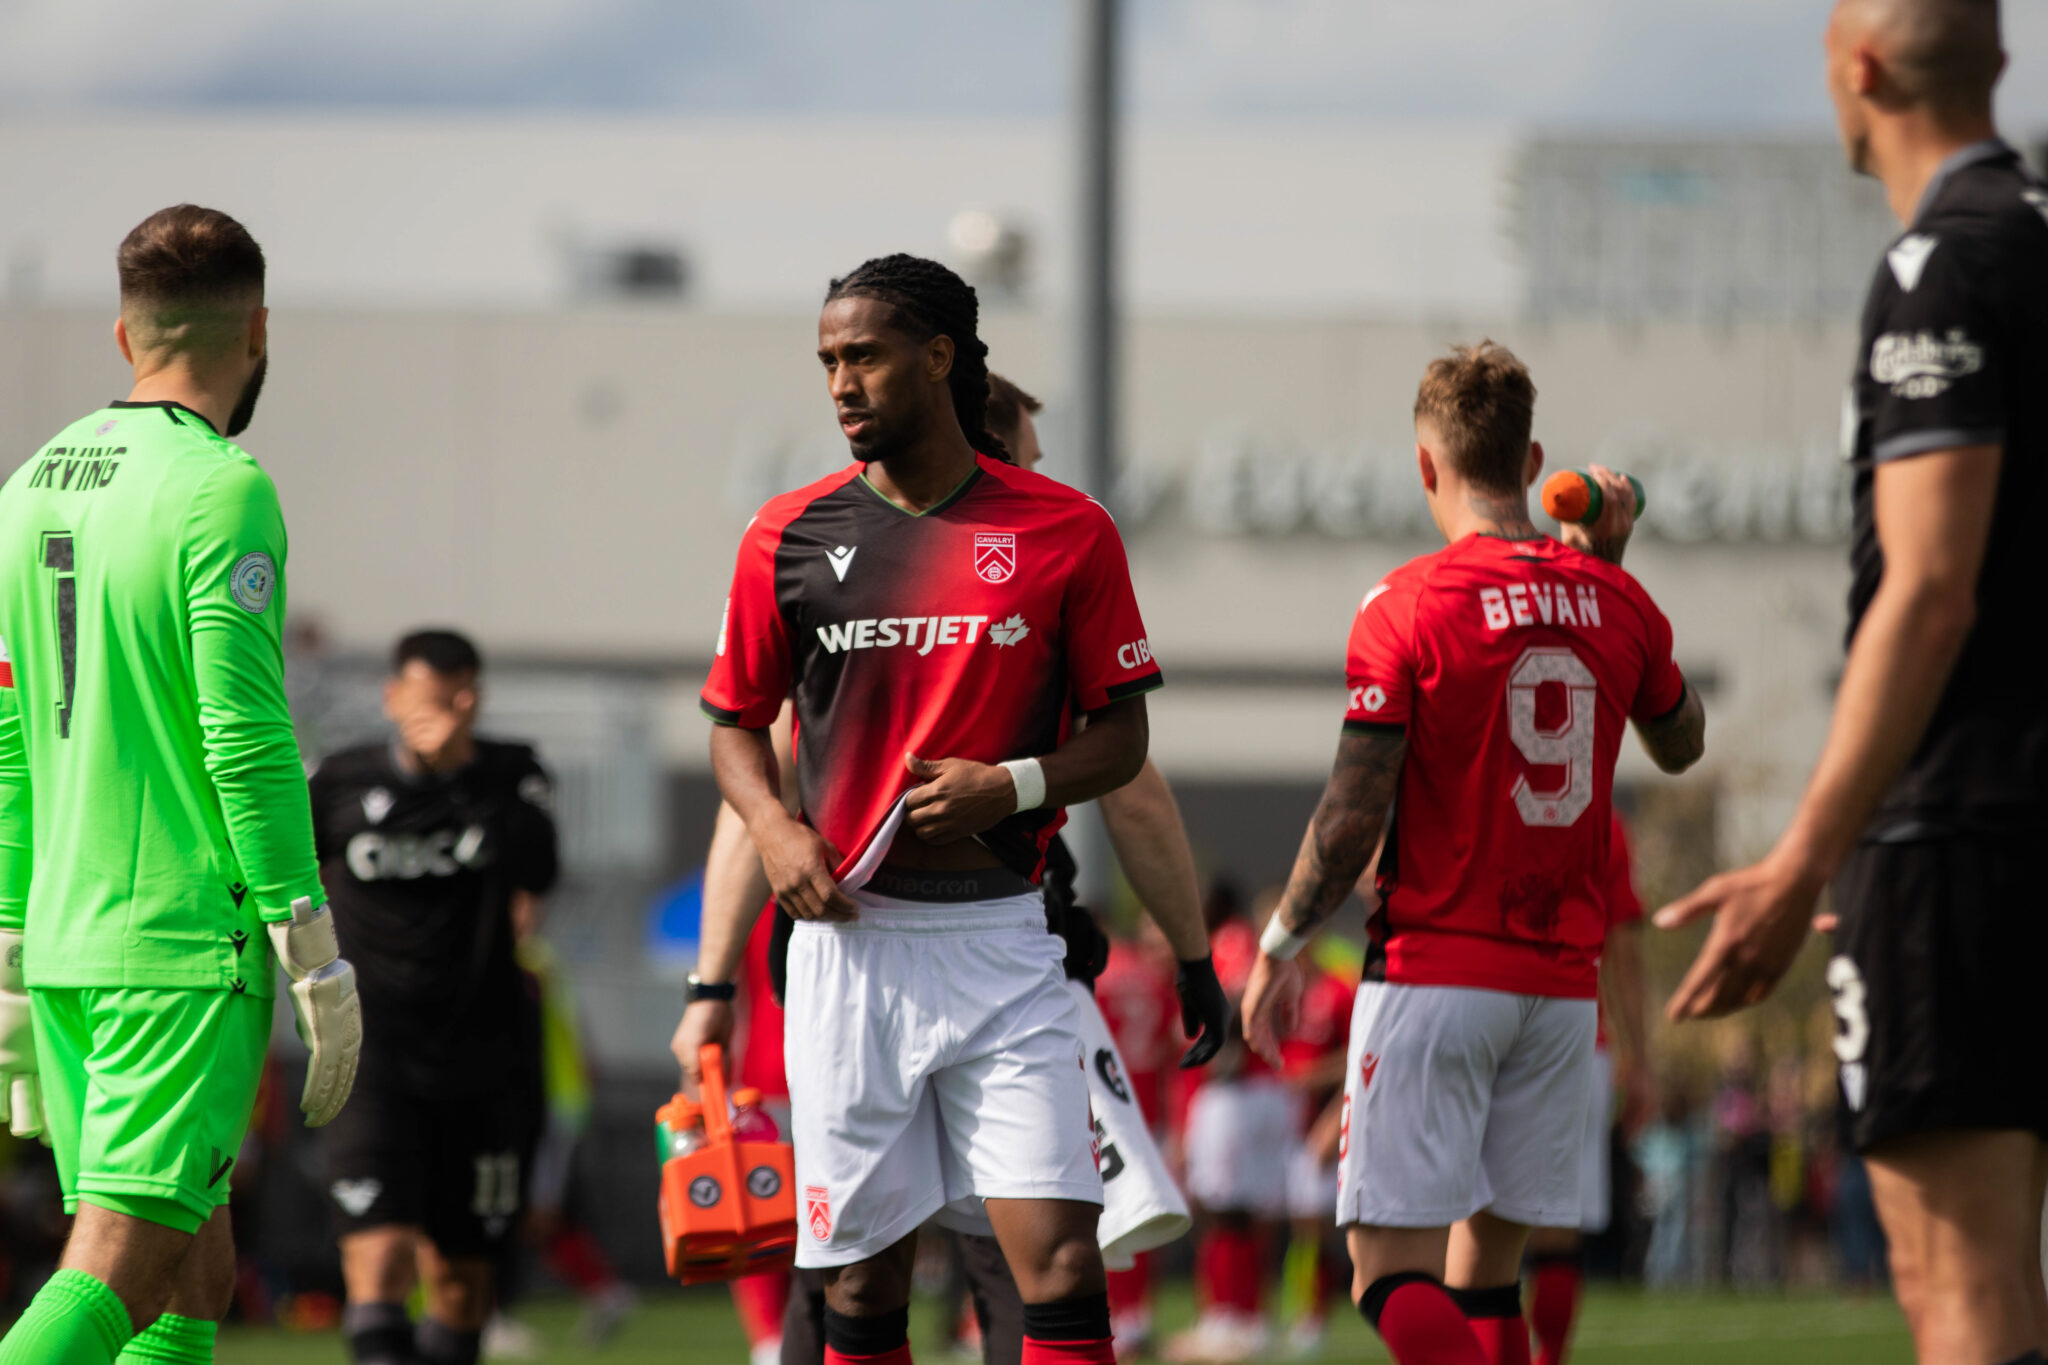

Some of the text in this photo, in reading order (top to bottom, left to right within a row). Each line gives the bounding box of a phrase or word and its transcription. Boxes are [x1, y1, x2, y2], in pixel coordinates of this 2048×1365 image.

[28, 446, 128, 491] IRVING
[1480, 583, 1601, 630] BEVAN
[38, 530, 76, 739] 1
[816, 614, 988, 657] WESTJET
[1506, 646, 1597, 827] 9
[878, 871, 979, 896] macron
